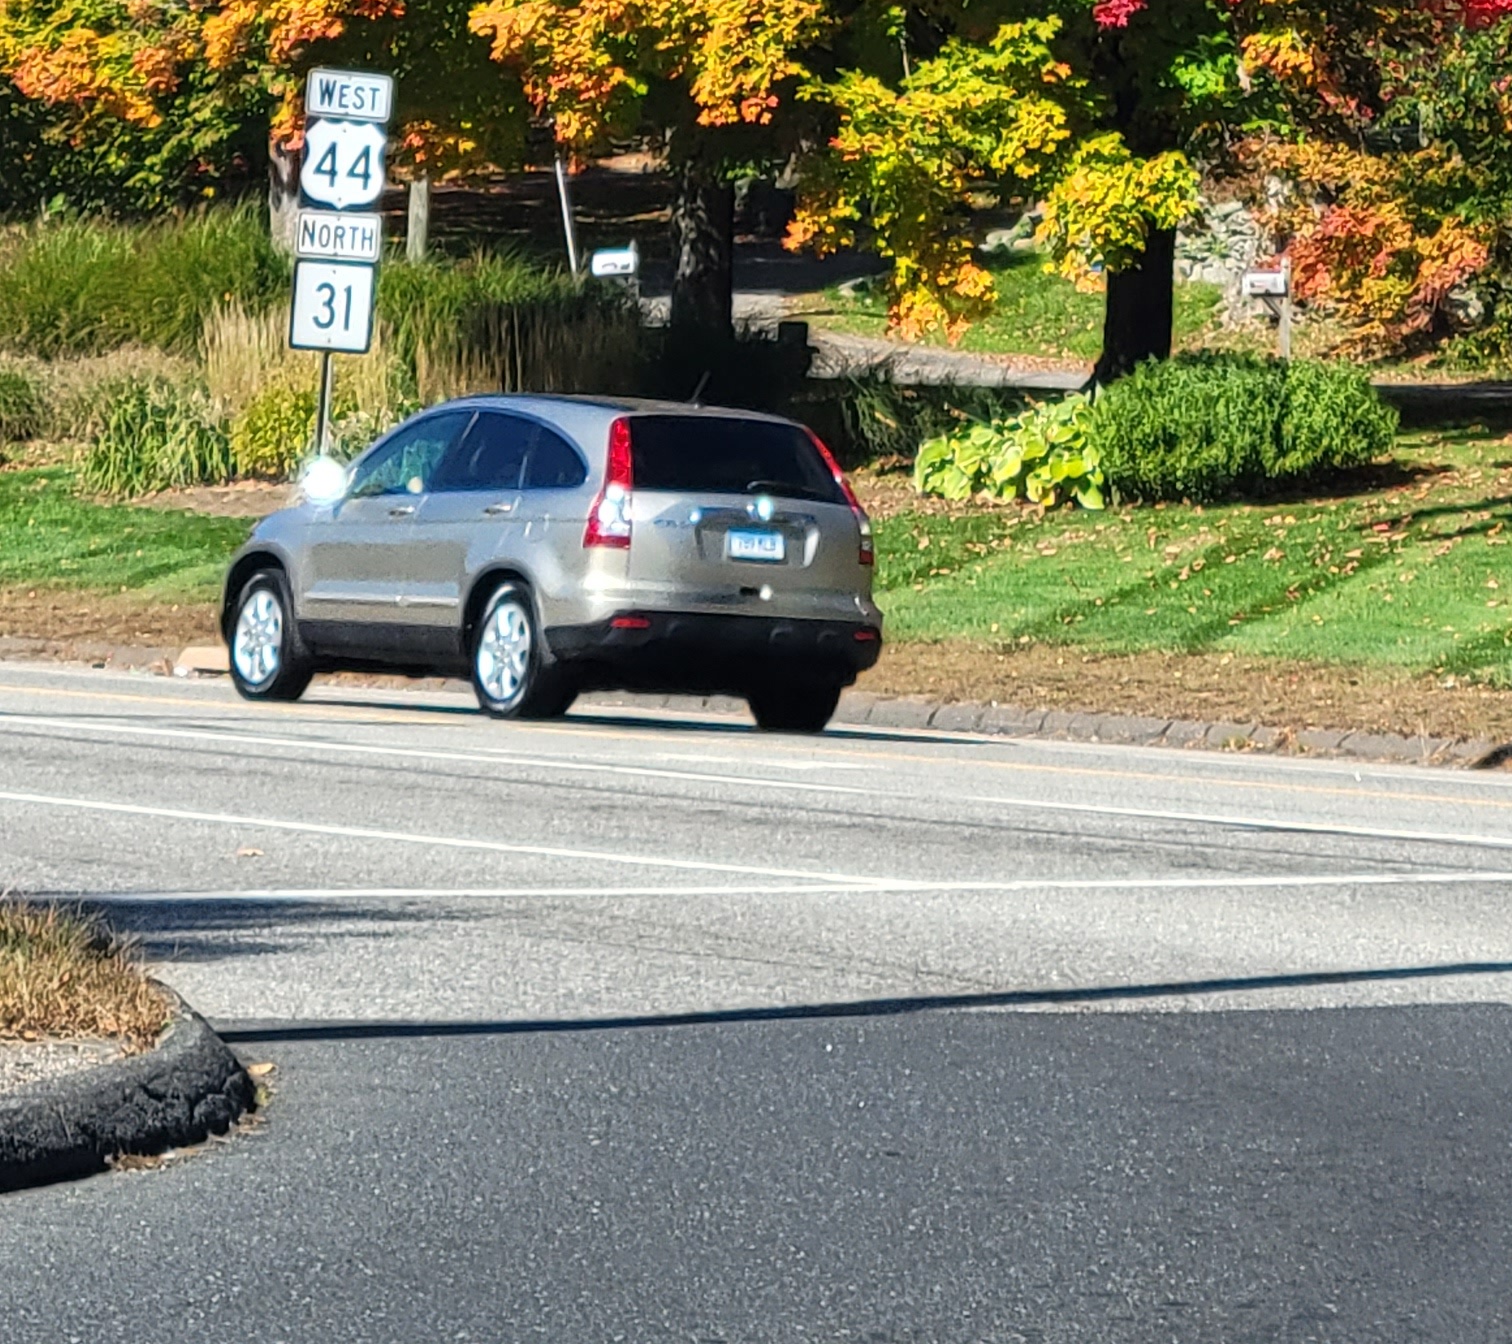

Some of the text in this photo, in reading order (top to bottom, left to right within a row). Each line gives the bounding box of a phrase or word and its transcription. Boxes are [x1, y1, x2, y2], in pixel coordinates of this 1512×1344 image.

[319, 78, 380, 111] WEST
[313, 141, 372, 191] 44
[301, 220, 374, 252] NORTH
[312, 282, 352, 332] 31
